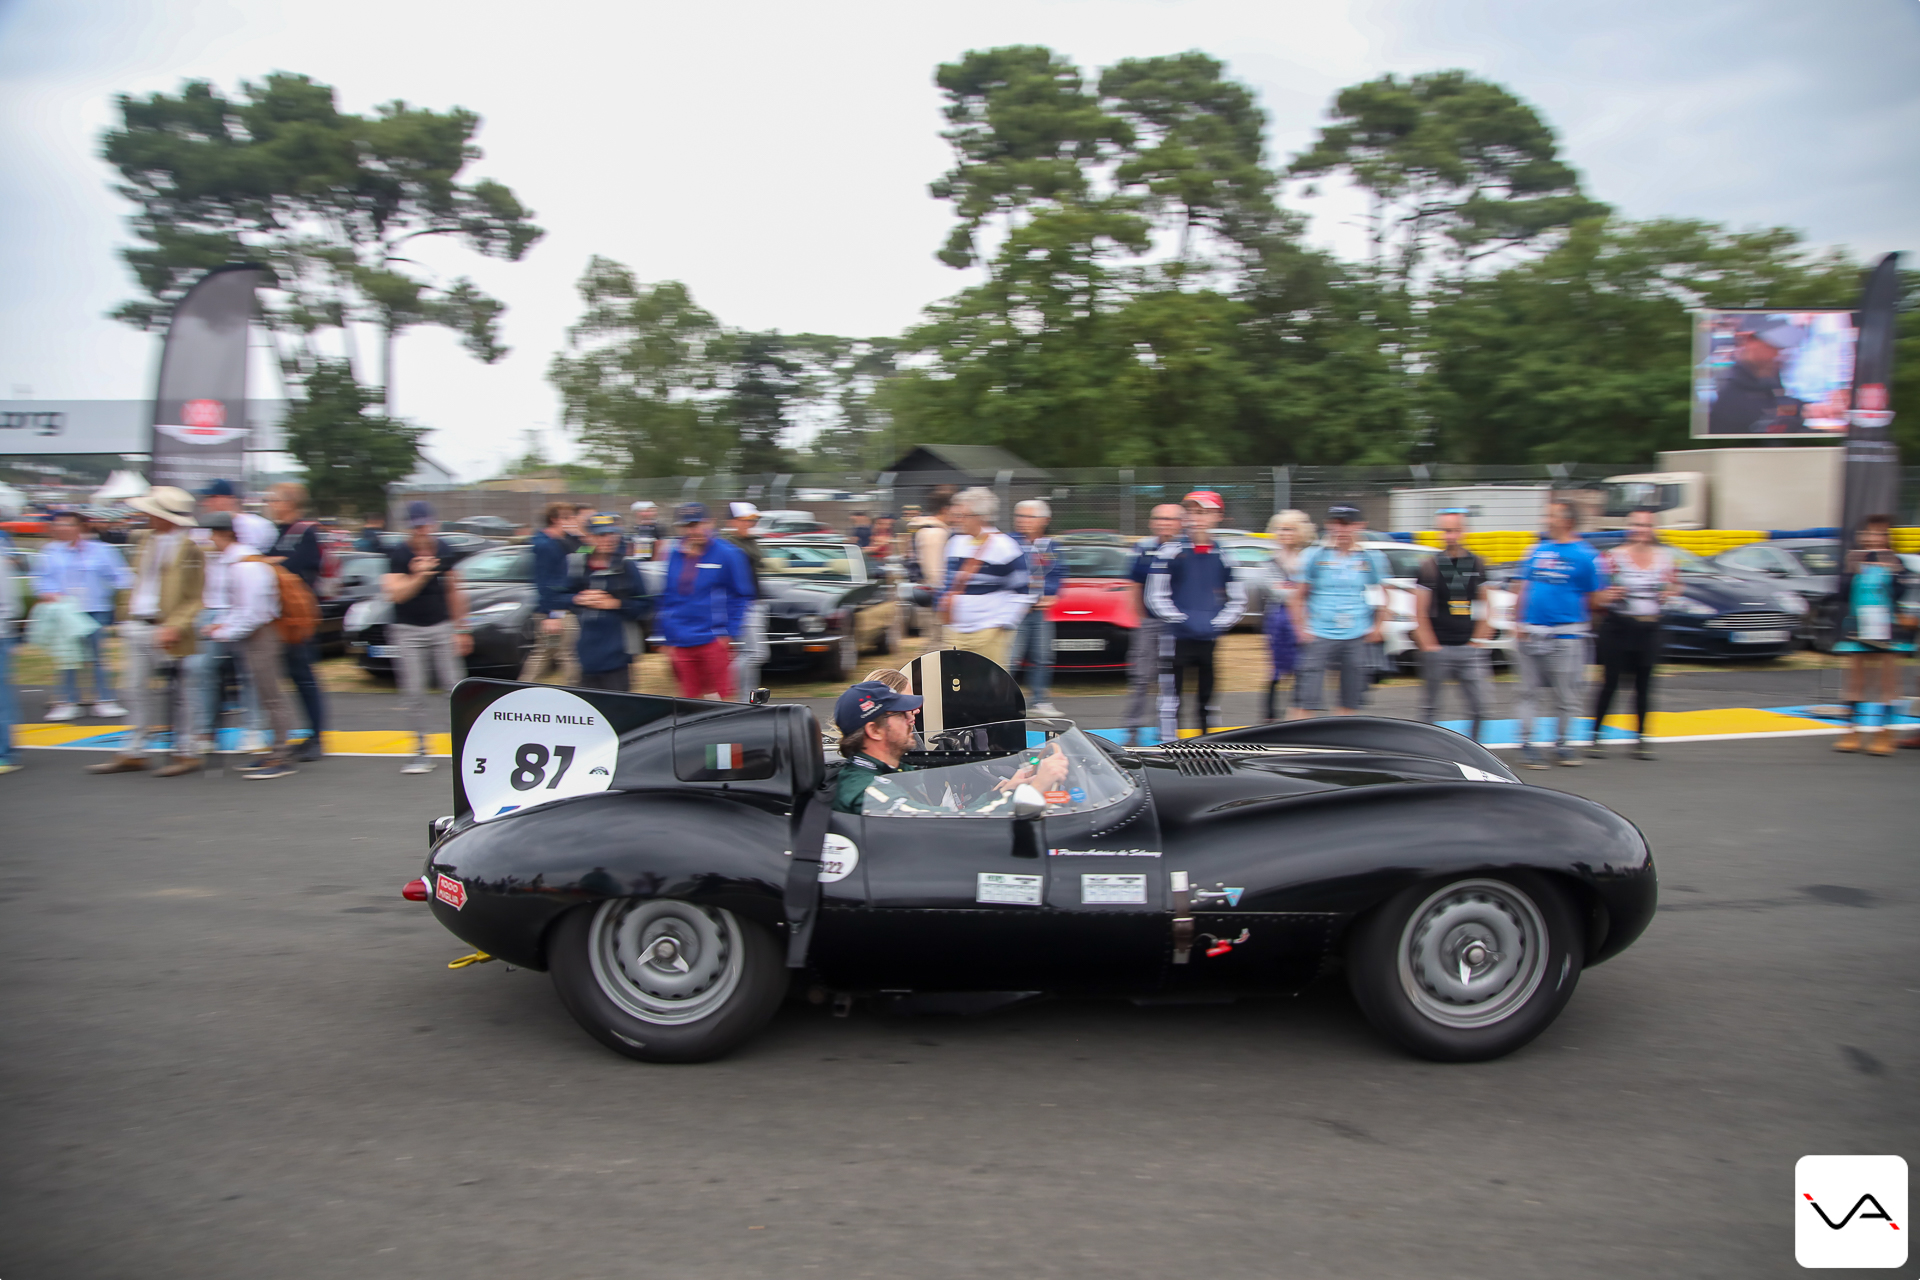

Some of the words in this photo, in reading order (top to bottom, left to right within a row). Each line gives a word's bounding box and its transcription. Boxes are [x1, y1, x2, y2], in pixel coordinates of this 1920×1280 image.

[493, 711, 551, 724] RICHARD
[555, 715, 595, 726] MILLE
[473, 758, 487, 774] 3
[510, 743, 576, 791] 87
[440, 878, 459, 893] 1000
